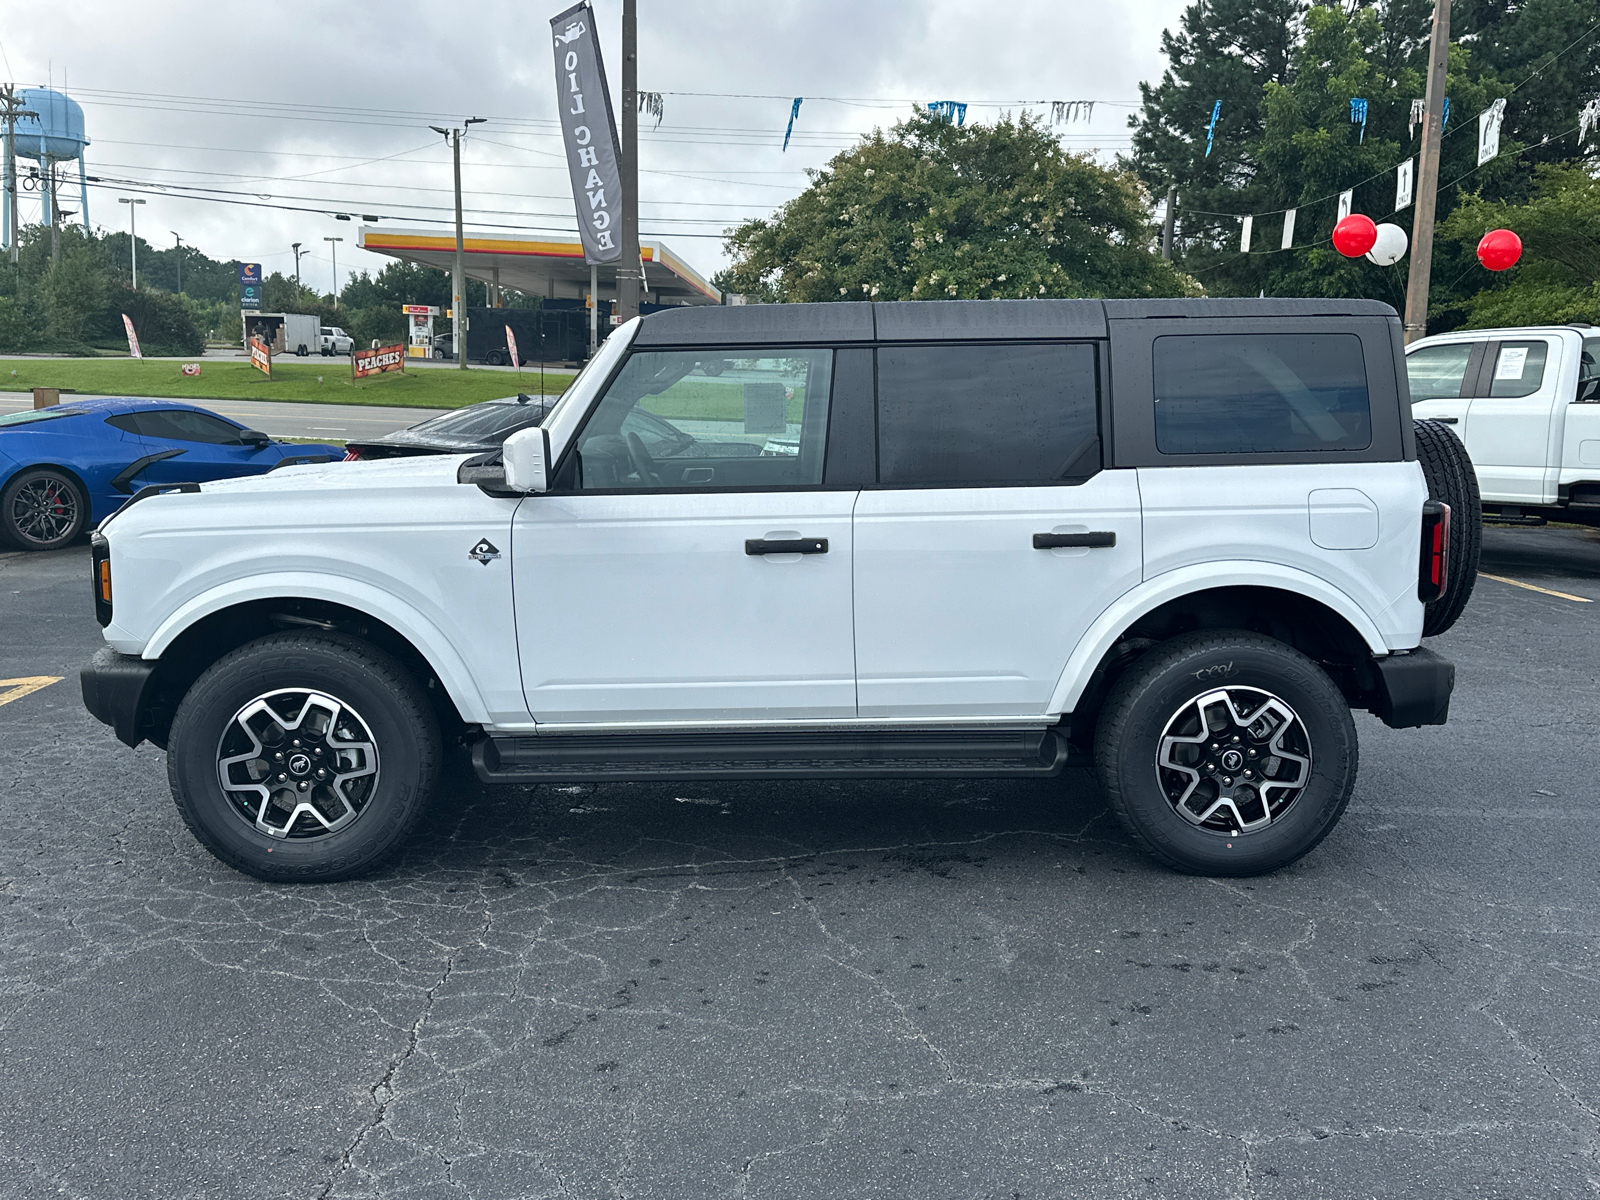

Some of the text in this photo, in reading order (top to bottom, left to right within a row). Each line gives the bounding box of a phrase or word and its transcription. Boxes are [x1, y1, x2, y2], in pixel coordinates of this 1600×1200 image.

[1480, 143, 1496, 159] ONLY
[1397, 192, 1410, 205] ONLY
[357, 351, 400, 371] PEACHES
